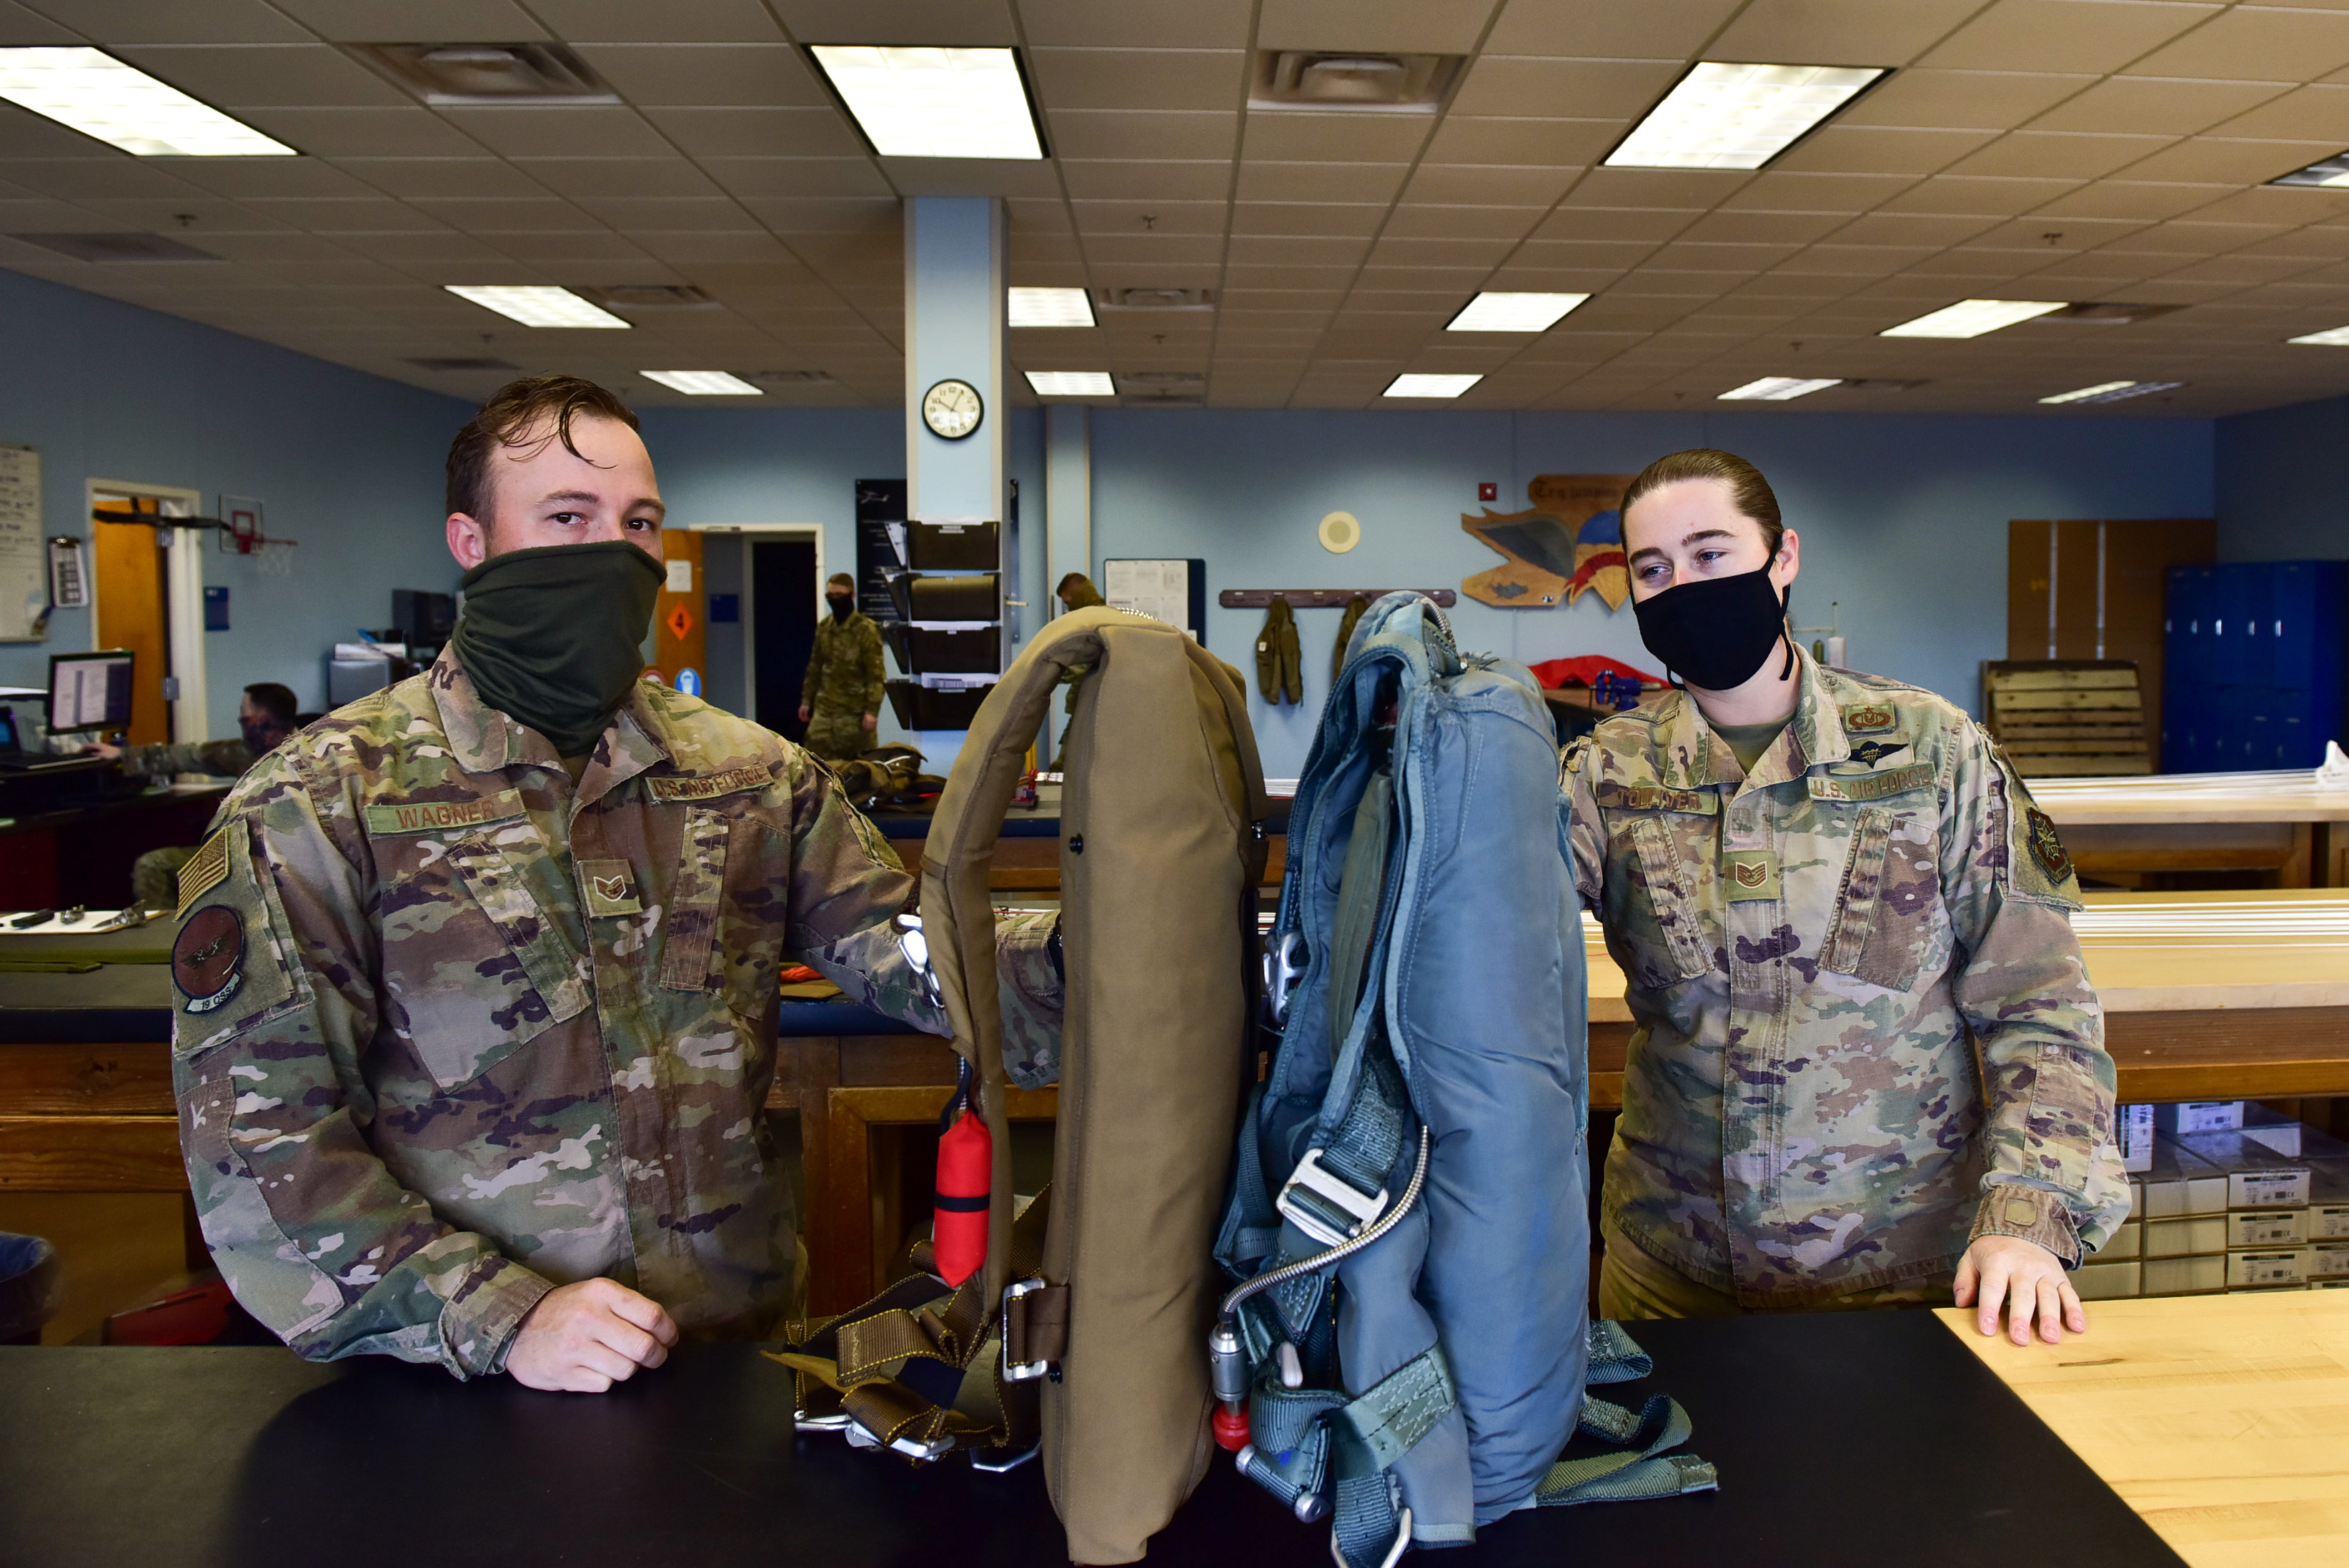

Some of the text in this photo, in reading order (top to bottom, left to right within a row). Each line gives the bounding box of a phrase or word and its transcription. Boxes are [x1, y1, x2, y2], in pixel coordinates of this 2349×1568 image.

[1813, 767, 1932, 800] U.S. AIR FORCE
[395, 800, 496, 828] WAGNER
[201, 986, 232, 1010] 19 OSS
